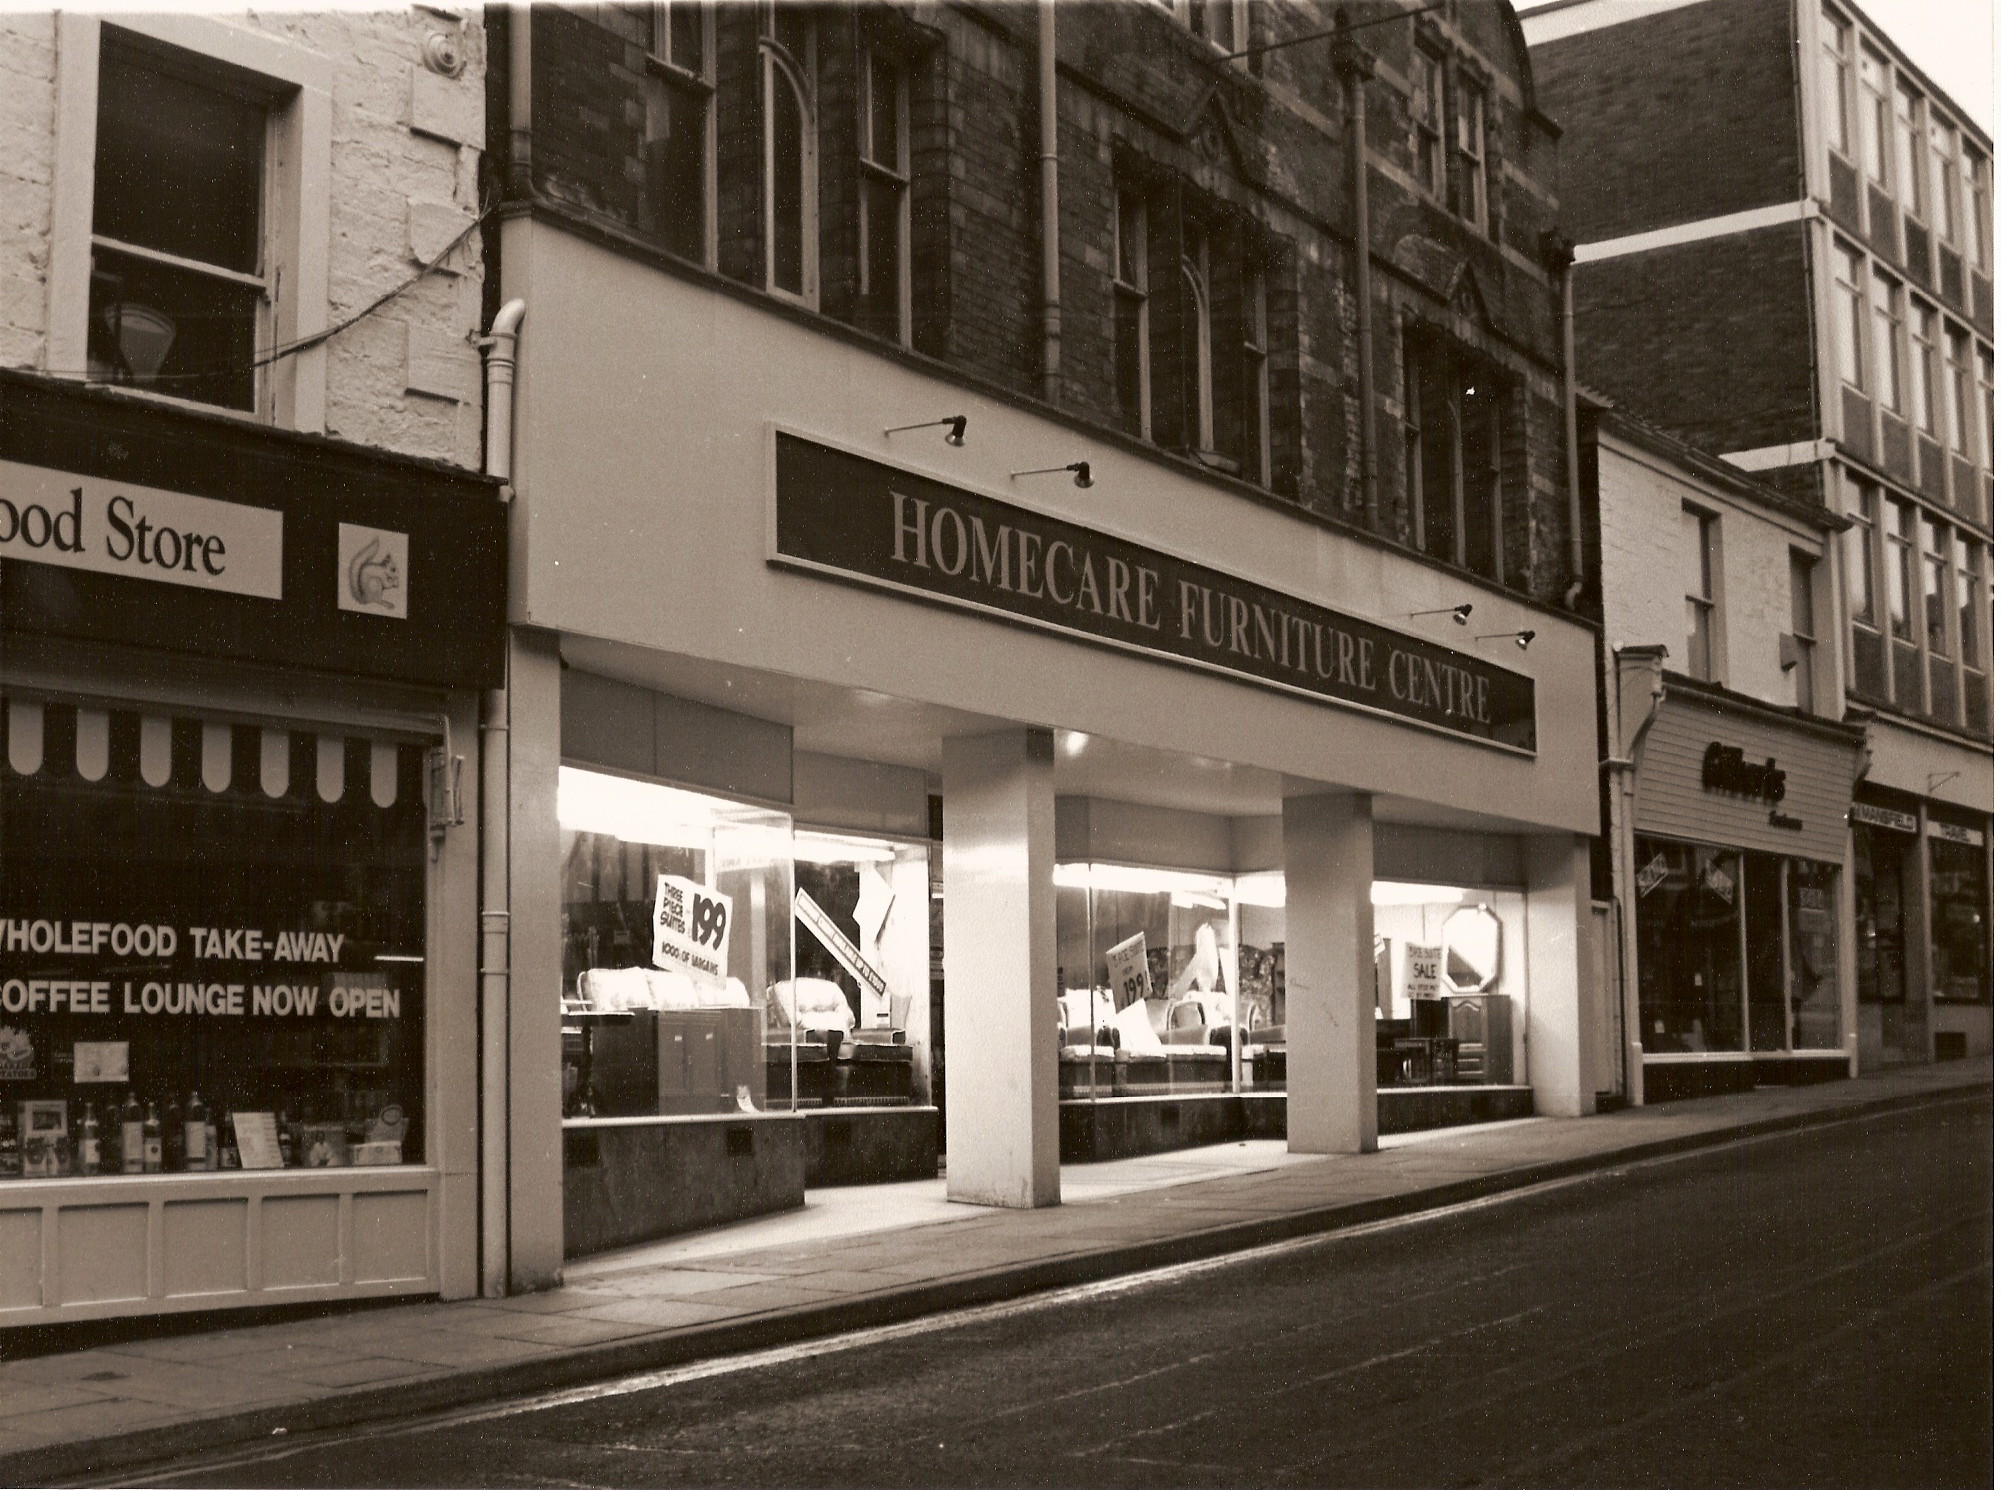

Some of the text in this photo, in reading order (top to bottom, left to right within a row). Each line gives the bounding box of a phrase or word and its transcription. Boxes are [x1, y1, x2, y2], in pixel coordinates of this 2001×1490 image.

[106, 495, 226, 576] Store
[889, 490, 1491, 725] HOMECARE FURNITURE CENTRE
[660, 911, 685, 934] SUITES
[691, 892, 727, 951] 199
[189, 926, 345, 964] TAKE-AWAY
[1413, 962, 1437, 979] SALE
[0, 979, 400, 1019] OFFEE LOUNGE NOW OPEN
